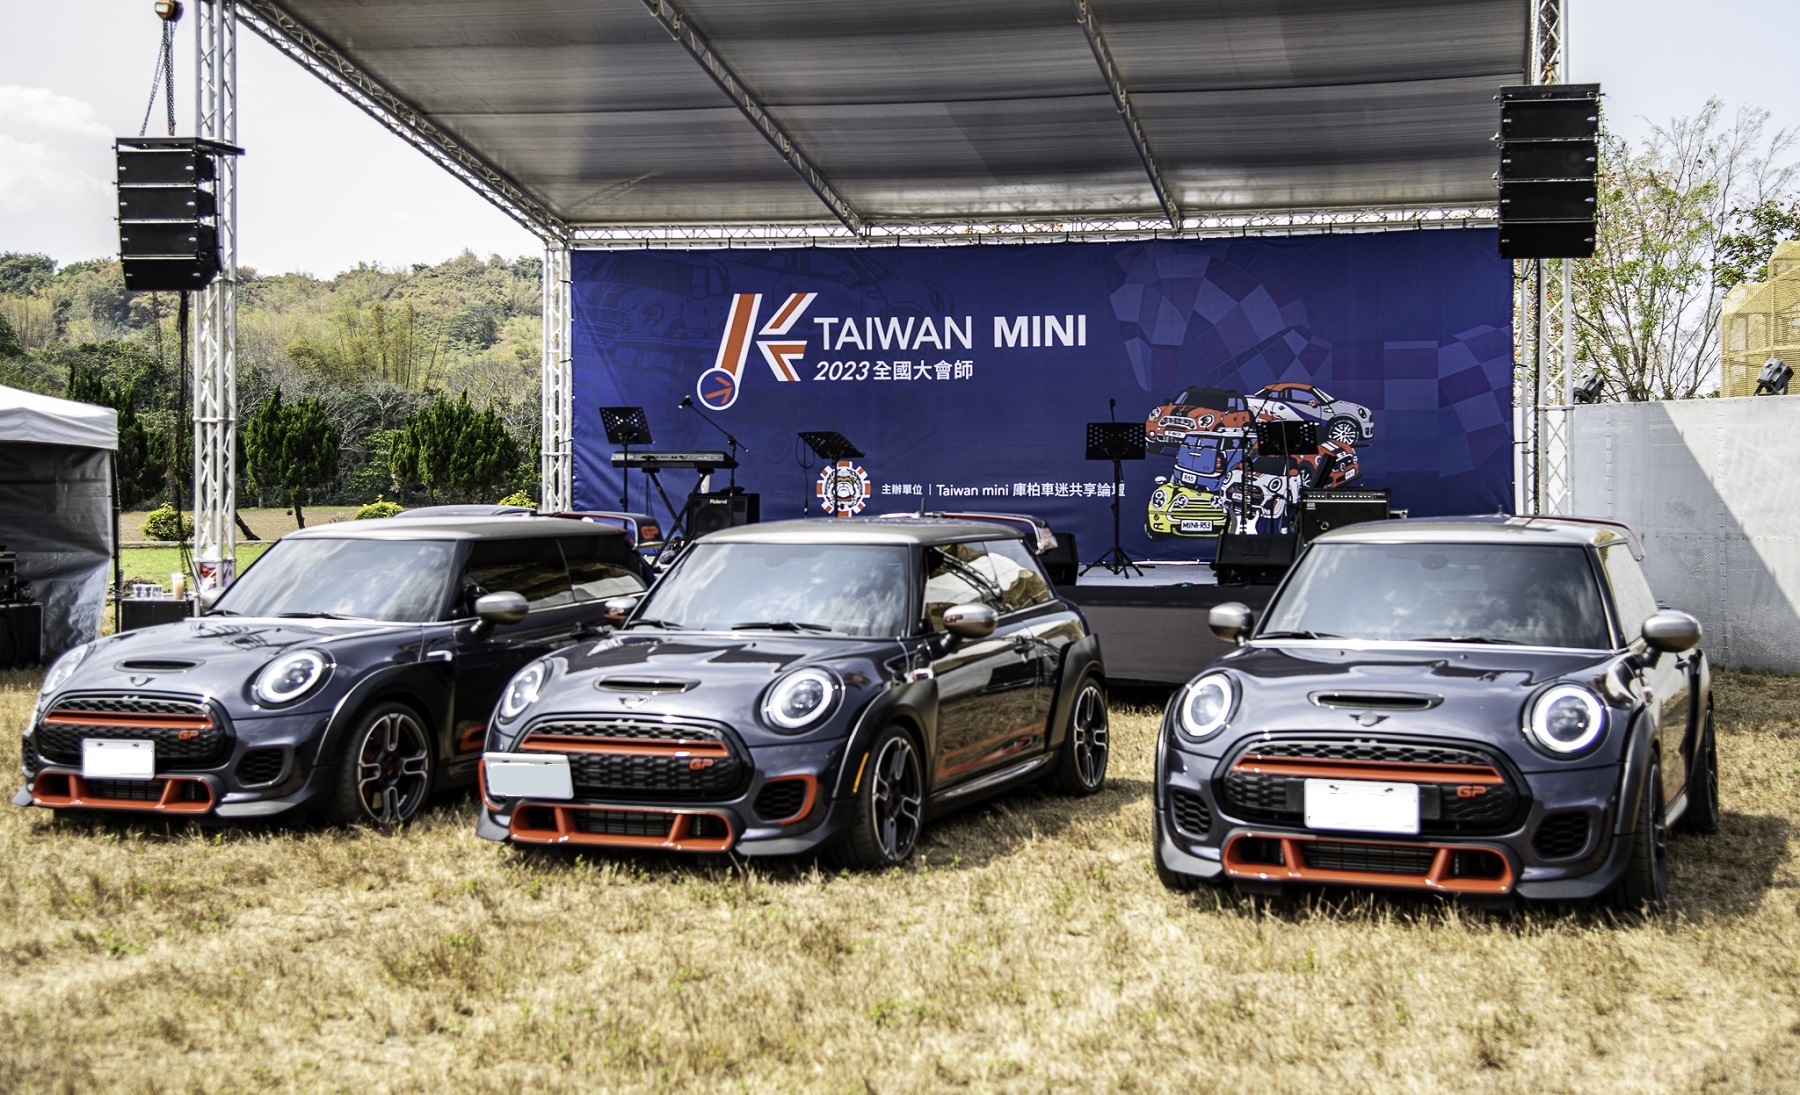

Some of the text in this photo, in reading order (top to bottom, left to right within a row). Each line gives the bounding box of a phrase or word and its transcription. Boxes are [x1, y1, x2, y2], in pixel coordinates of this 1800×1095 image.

[813, 314, 1087, 351] TAIWAN MINI
[881, 483, 923, 495] 主辦單位
[936, 484, 979, 497] Taiwan
[982, 484, 1009, 496] mini
[178, 729, 199, 741] GP
[690, 758, 714, 770] GP
[1456, 785, 1487, 798] GP
